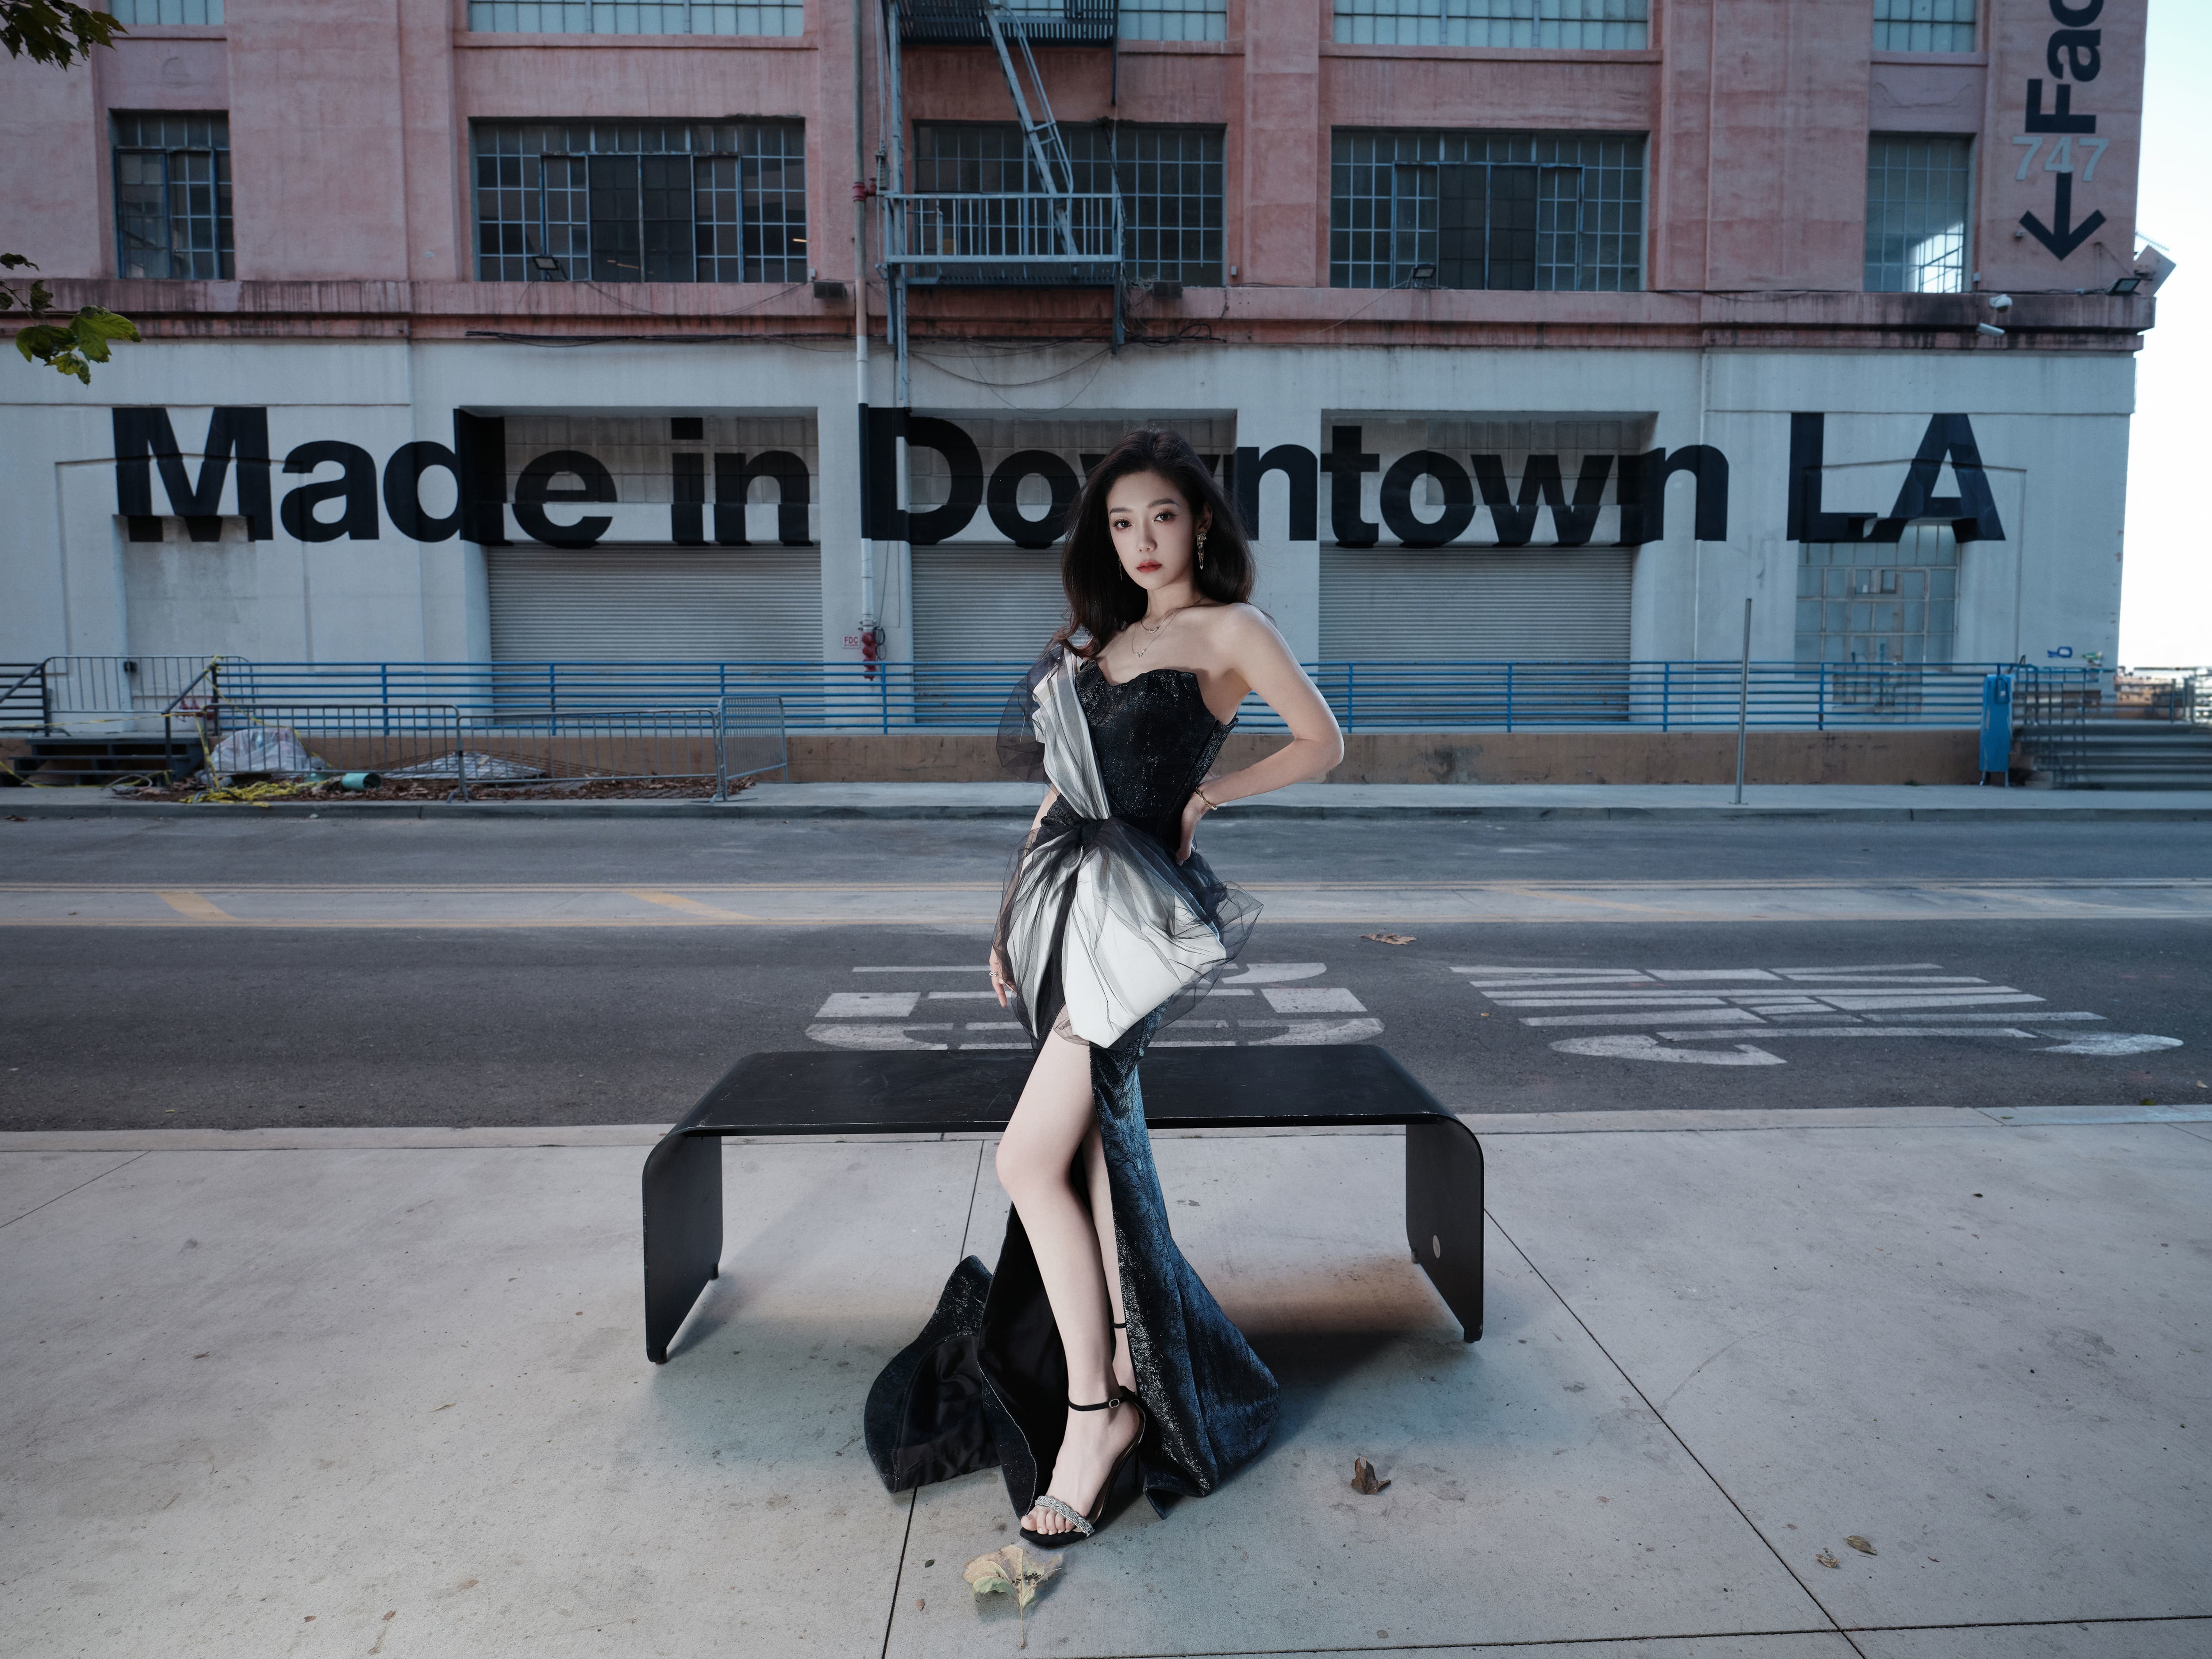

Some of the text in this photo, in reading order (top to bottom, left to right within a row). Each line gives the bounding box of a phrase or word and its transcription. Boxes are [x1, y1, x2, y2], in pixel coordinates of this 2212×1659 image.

[2012, 136, 2110, 182] 747
[112, 403, 2006, 549] Made in Dontown LA
[1448, 963, 2184, 1065] XING
